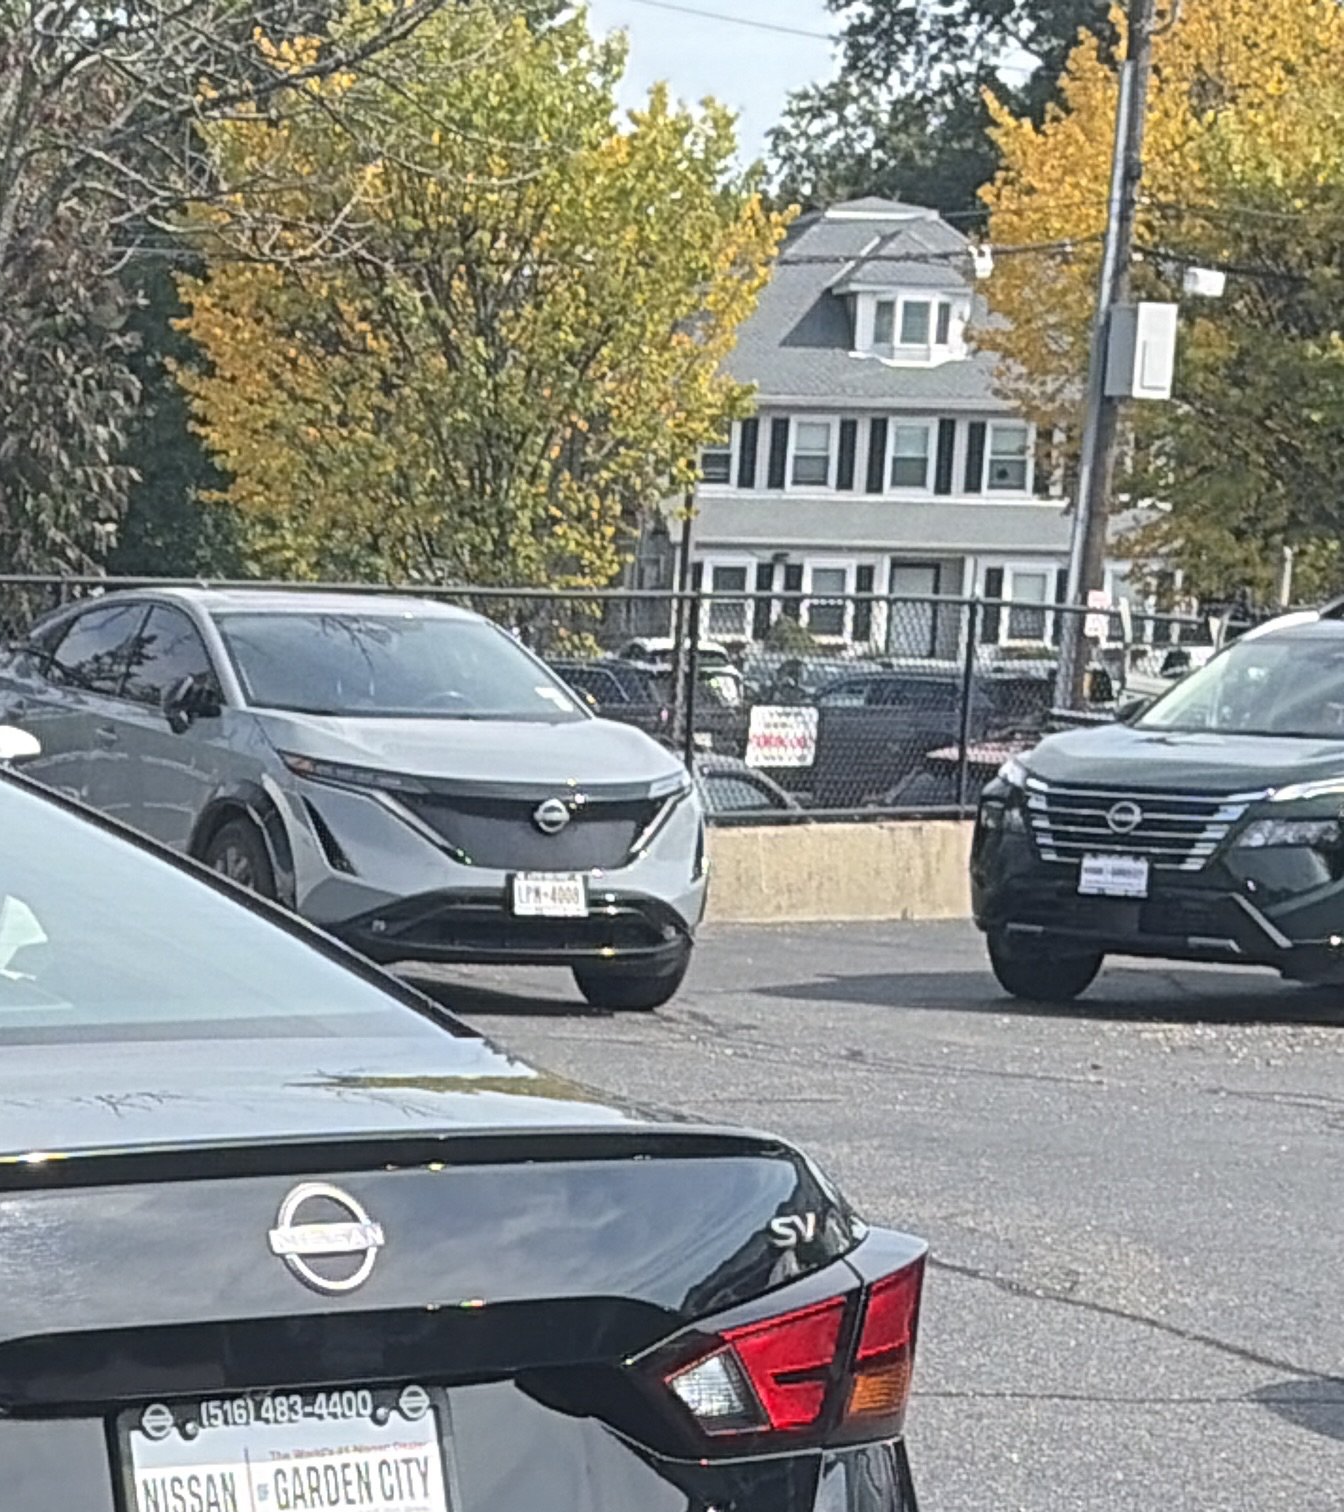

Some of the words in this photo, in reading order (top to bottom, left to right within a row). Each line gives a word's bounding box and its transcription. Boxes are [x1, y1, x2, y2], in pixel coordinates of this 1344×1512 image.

[276, 1223, 384, 1250] NISSAN
[770, 1211, 816, 1248] SV
[200, 1398, 254, 1427] (516)
[261, 1390, 373, 1424] 483-4400
[274, 1461, 374, 1510] GARDEN
[378, 1456, 429, 1501] CITY
